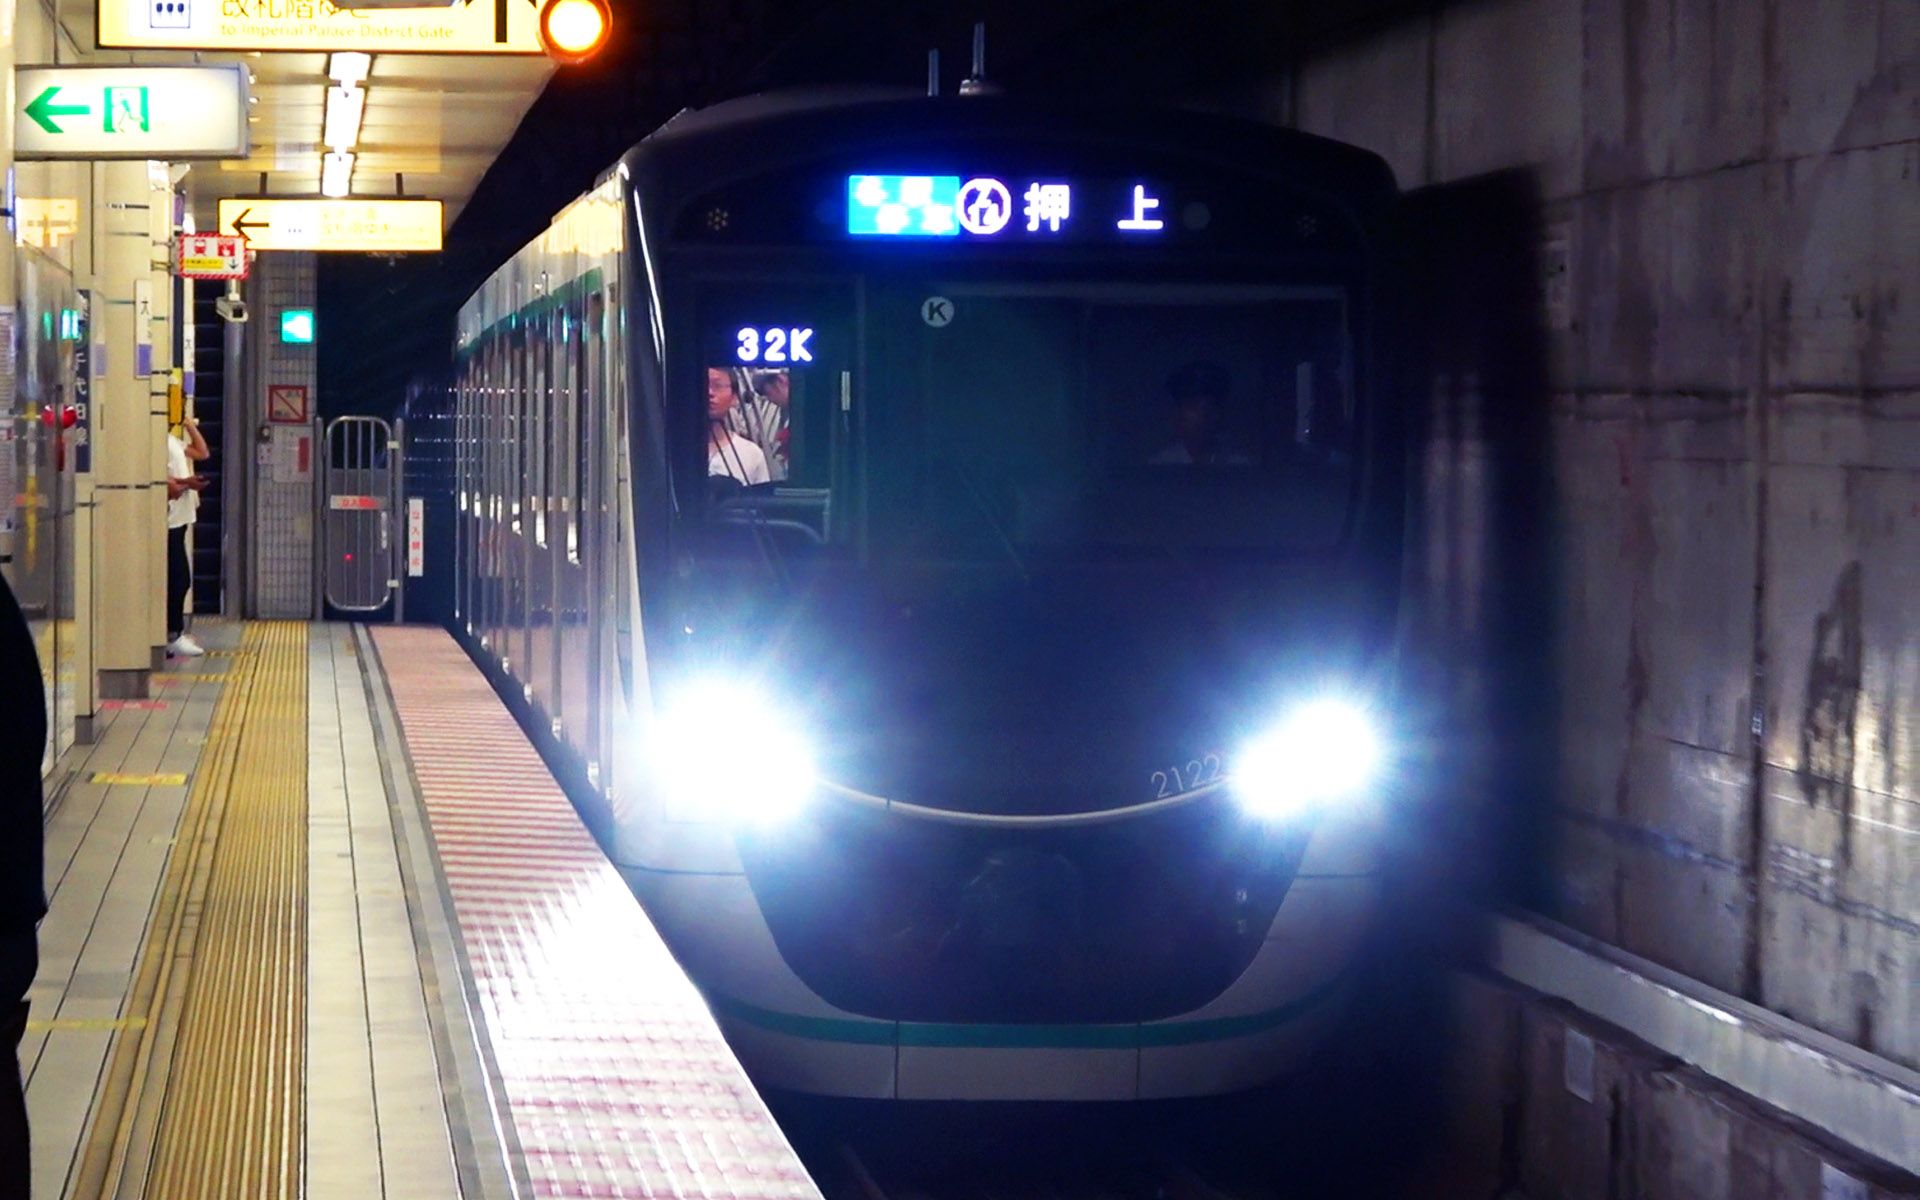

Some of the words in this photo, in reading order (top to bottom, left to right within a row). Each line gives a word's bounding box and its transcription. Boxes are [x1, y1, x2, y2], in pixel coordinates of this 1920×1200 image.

[418, 25, 454, 38] Gate
[928, 302, 948, 321] K
[737, 327, 814, 362] 32K
[1150, 753, 1222, 798] 2122
